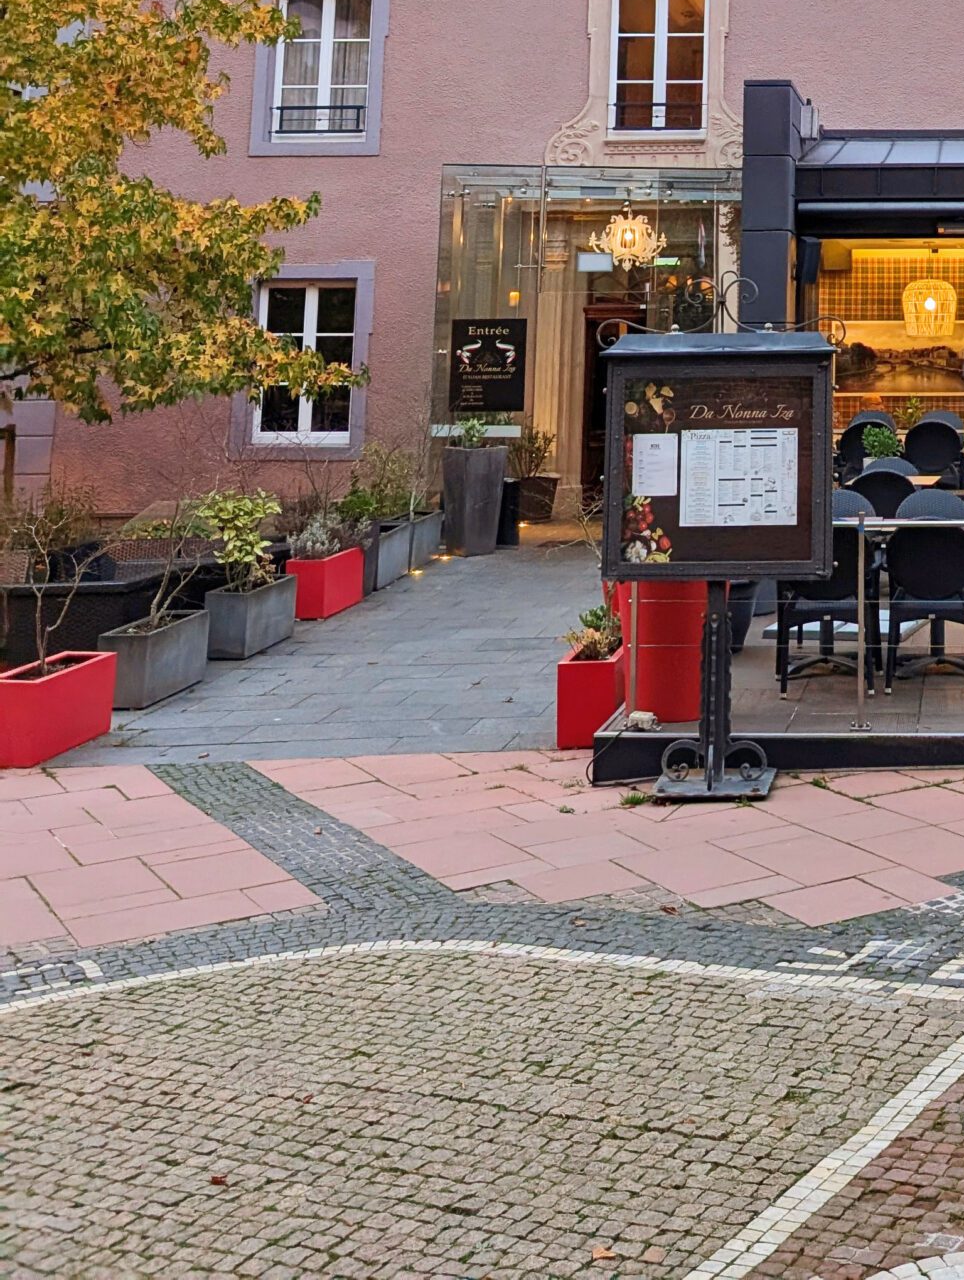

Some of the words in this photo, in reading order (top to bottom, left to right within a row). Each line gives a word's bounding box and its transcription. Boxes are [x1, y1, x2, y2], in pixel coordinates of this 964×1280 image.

[468, 326, 510, 335] Entrée
[689, 404, 715, 419] Da
[716, 402, 768, 419] Nonna
[770, 404, 794, 421] Iza
[689, 432, 711, 440] Pizza
